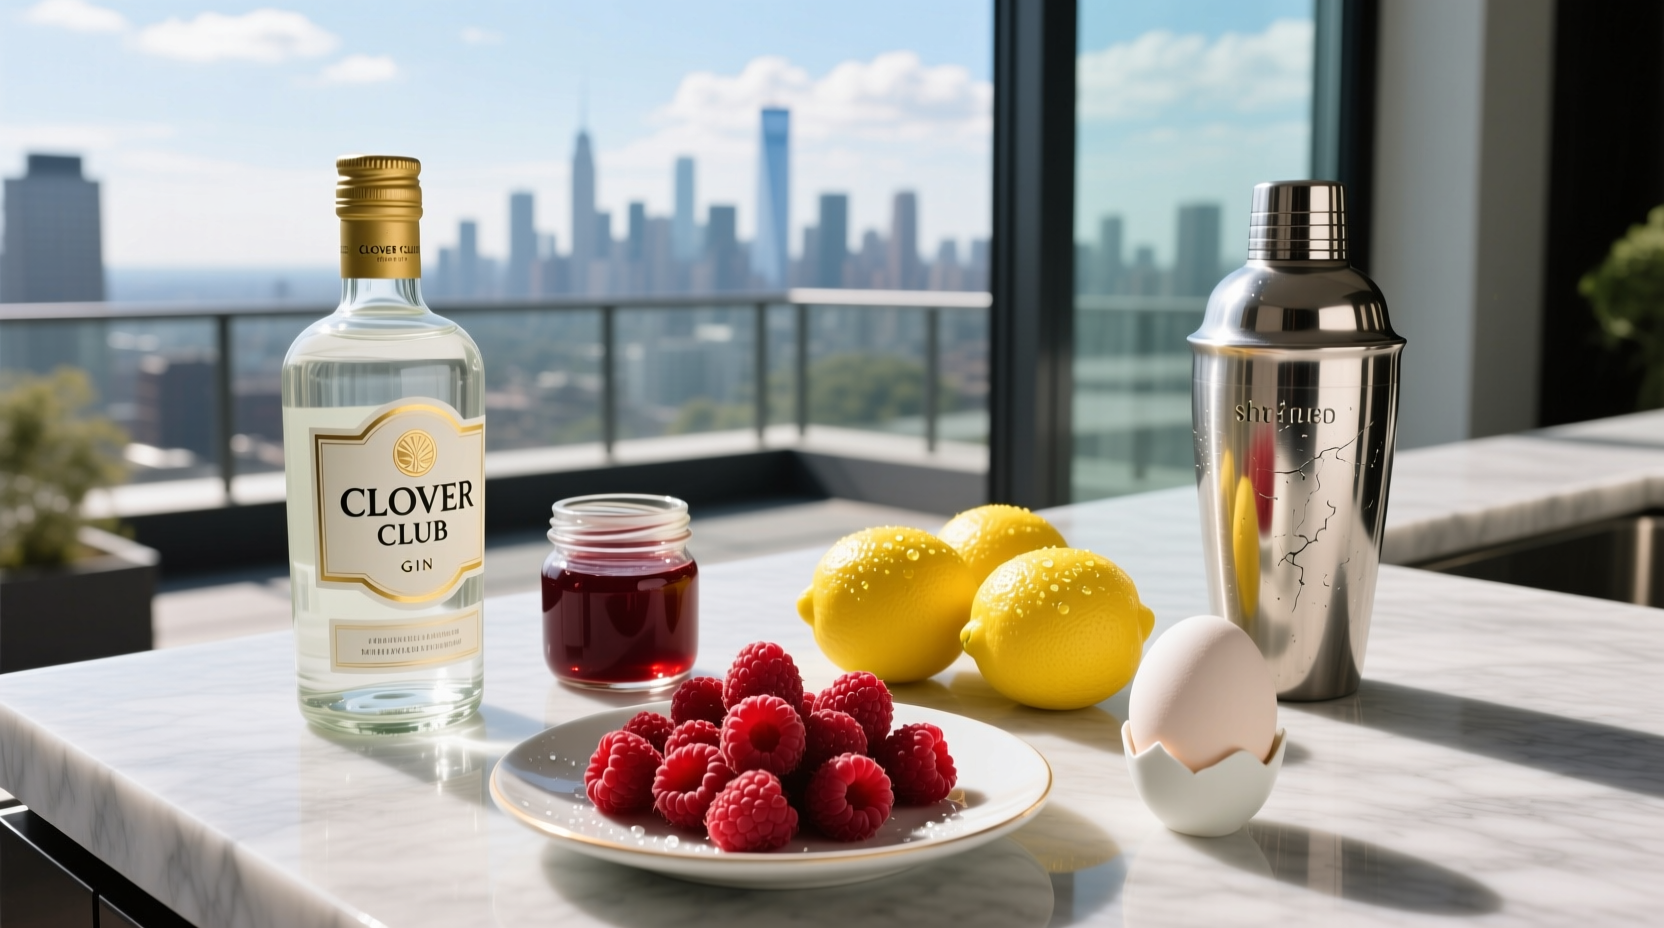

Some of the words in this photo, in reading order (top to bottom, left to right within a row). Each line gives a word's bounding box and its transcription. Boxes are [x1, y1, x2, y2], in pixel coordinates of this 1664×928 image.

[340, 480, 474, 518] CLOVER
[377, 519, 448, 546] CLUB
[401, 557, 433, 573] GIN
